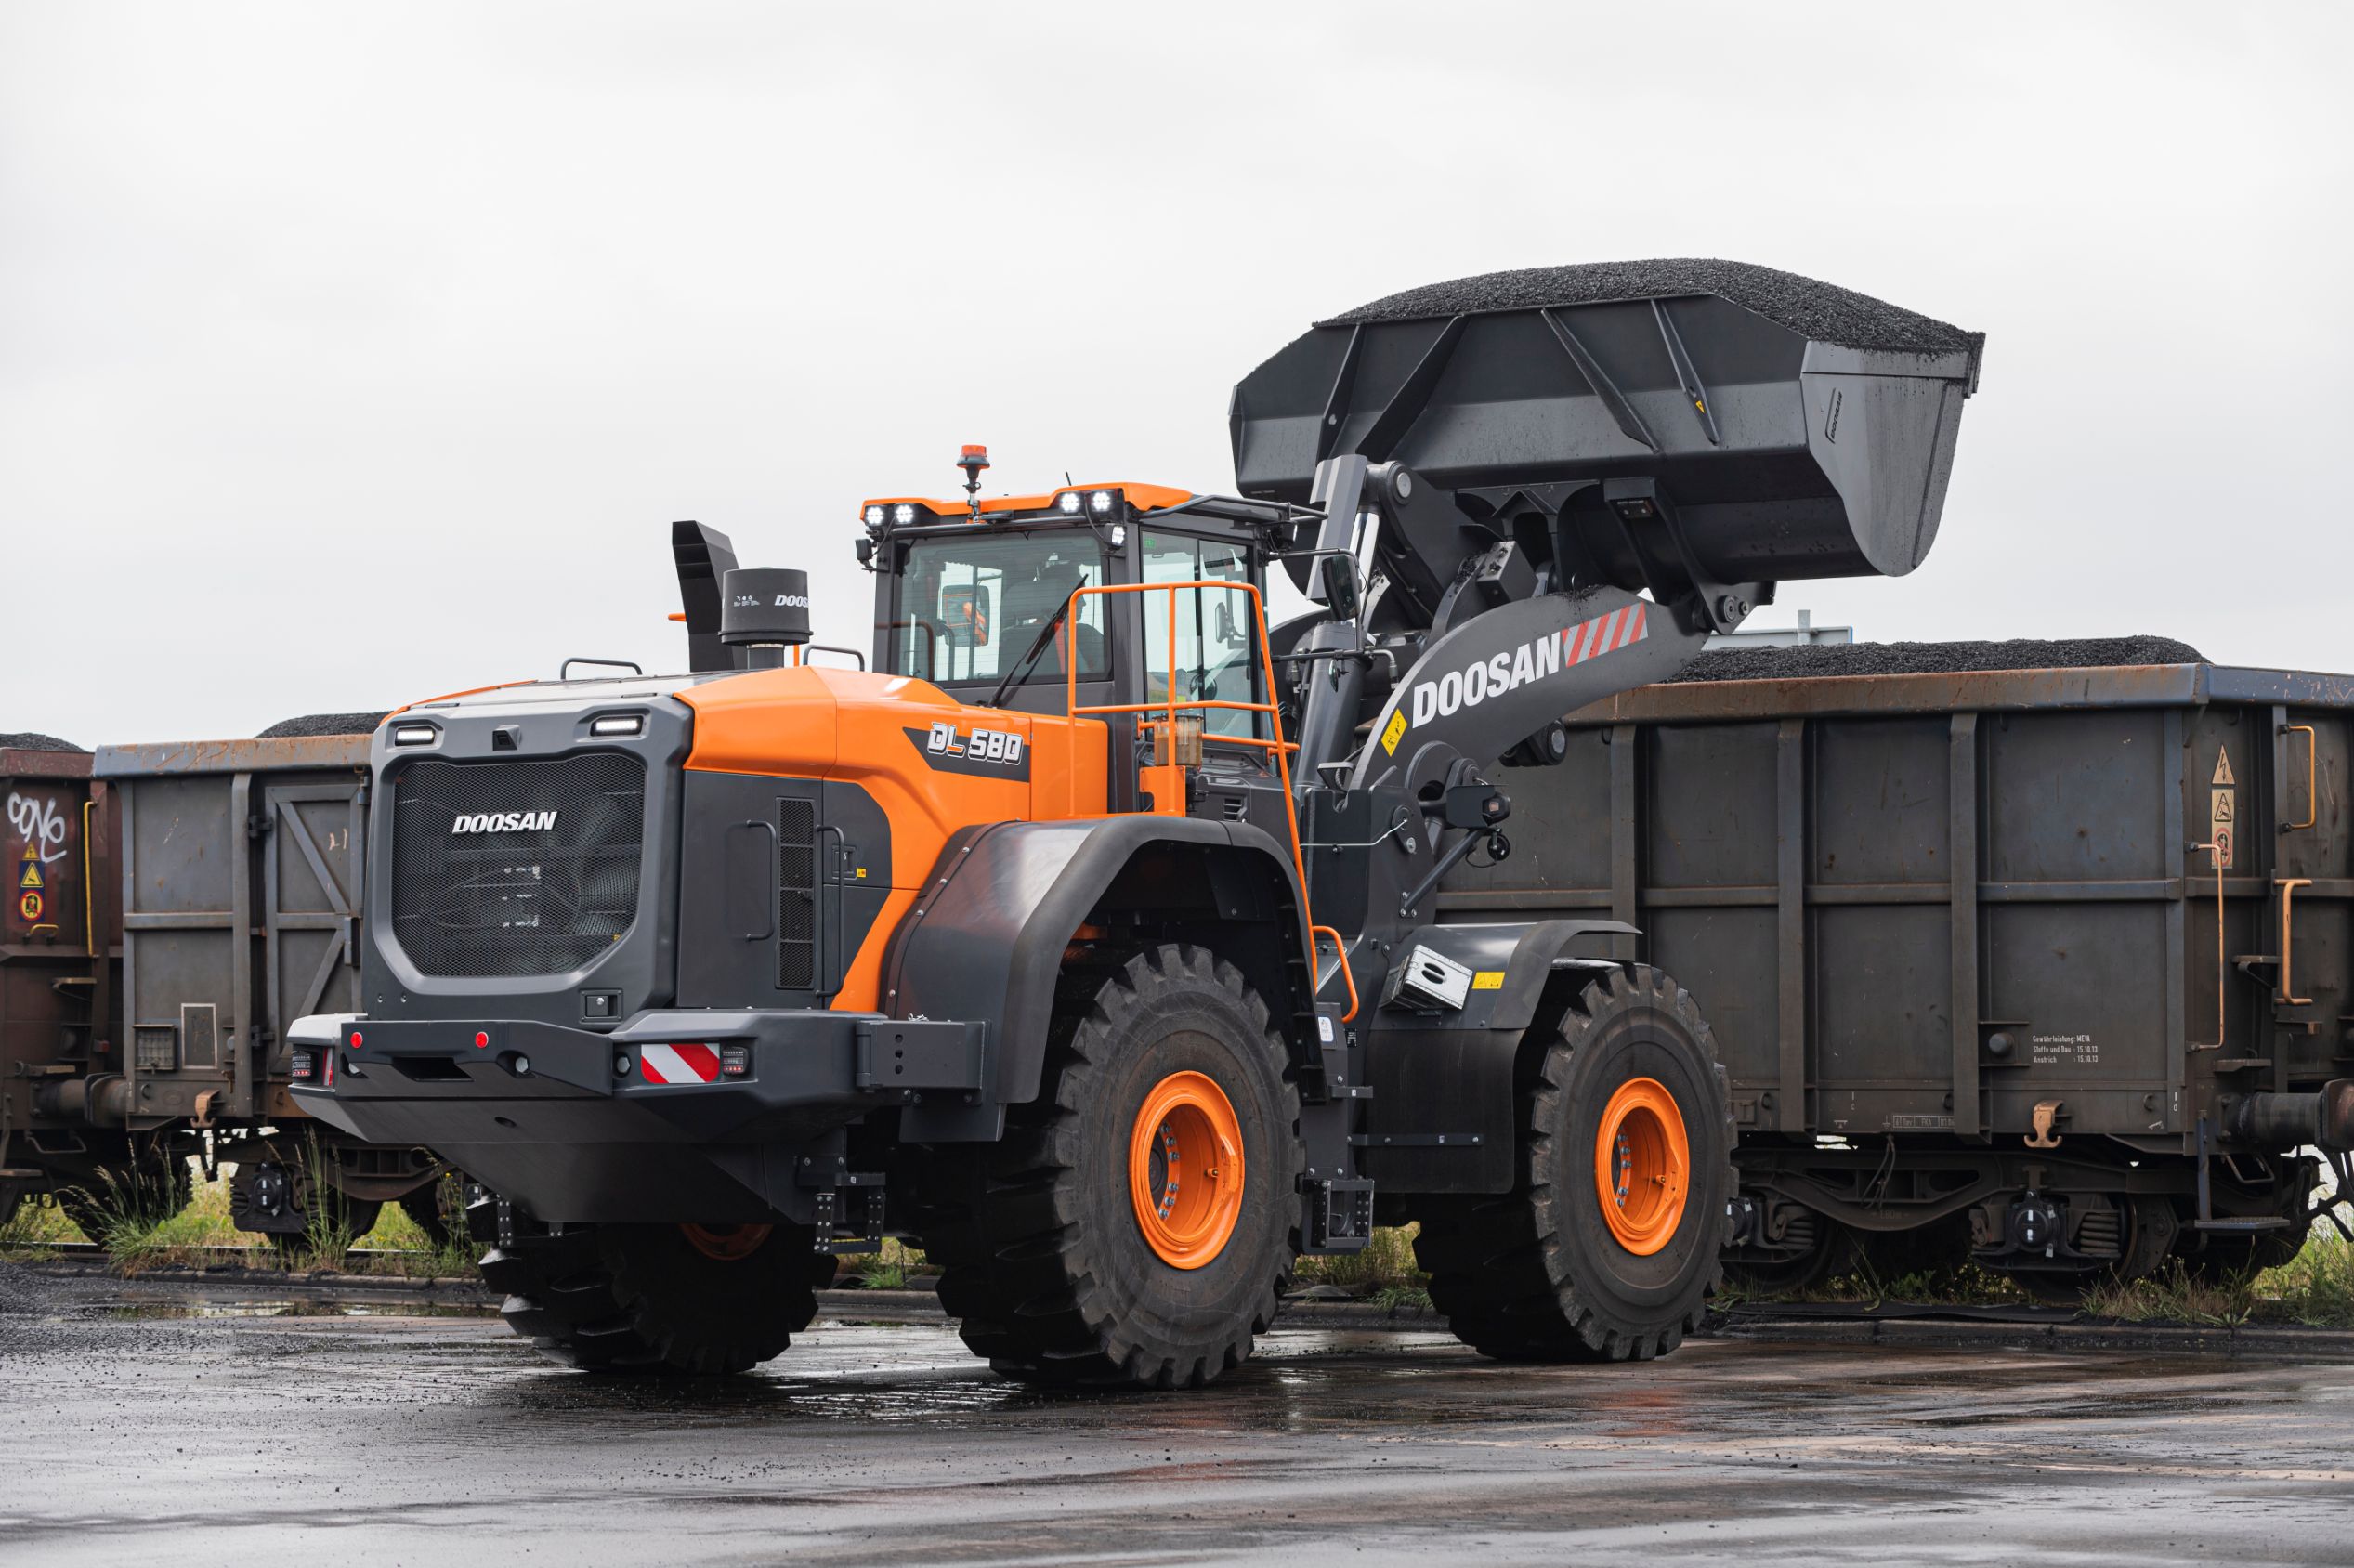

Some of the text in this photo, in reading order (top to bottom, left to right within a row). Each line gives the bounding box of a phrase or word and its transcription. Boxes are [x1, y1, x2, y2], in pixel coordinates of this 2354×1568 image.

[1830, 391, 1842, 439] DOOSAN
[1412, 631, 1561, 729] DOOSAN
[927, 721, 1024, 765] DL 580
[451, 811, 557, 834] DOOSAN
